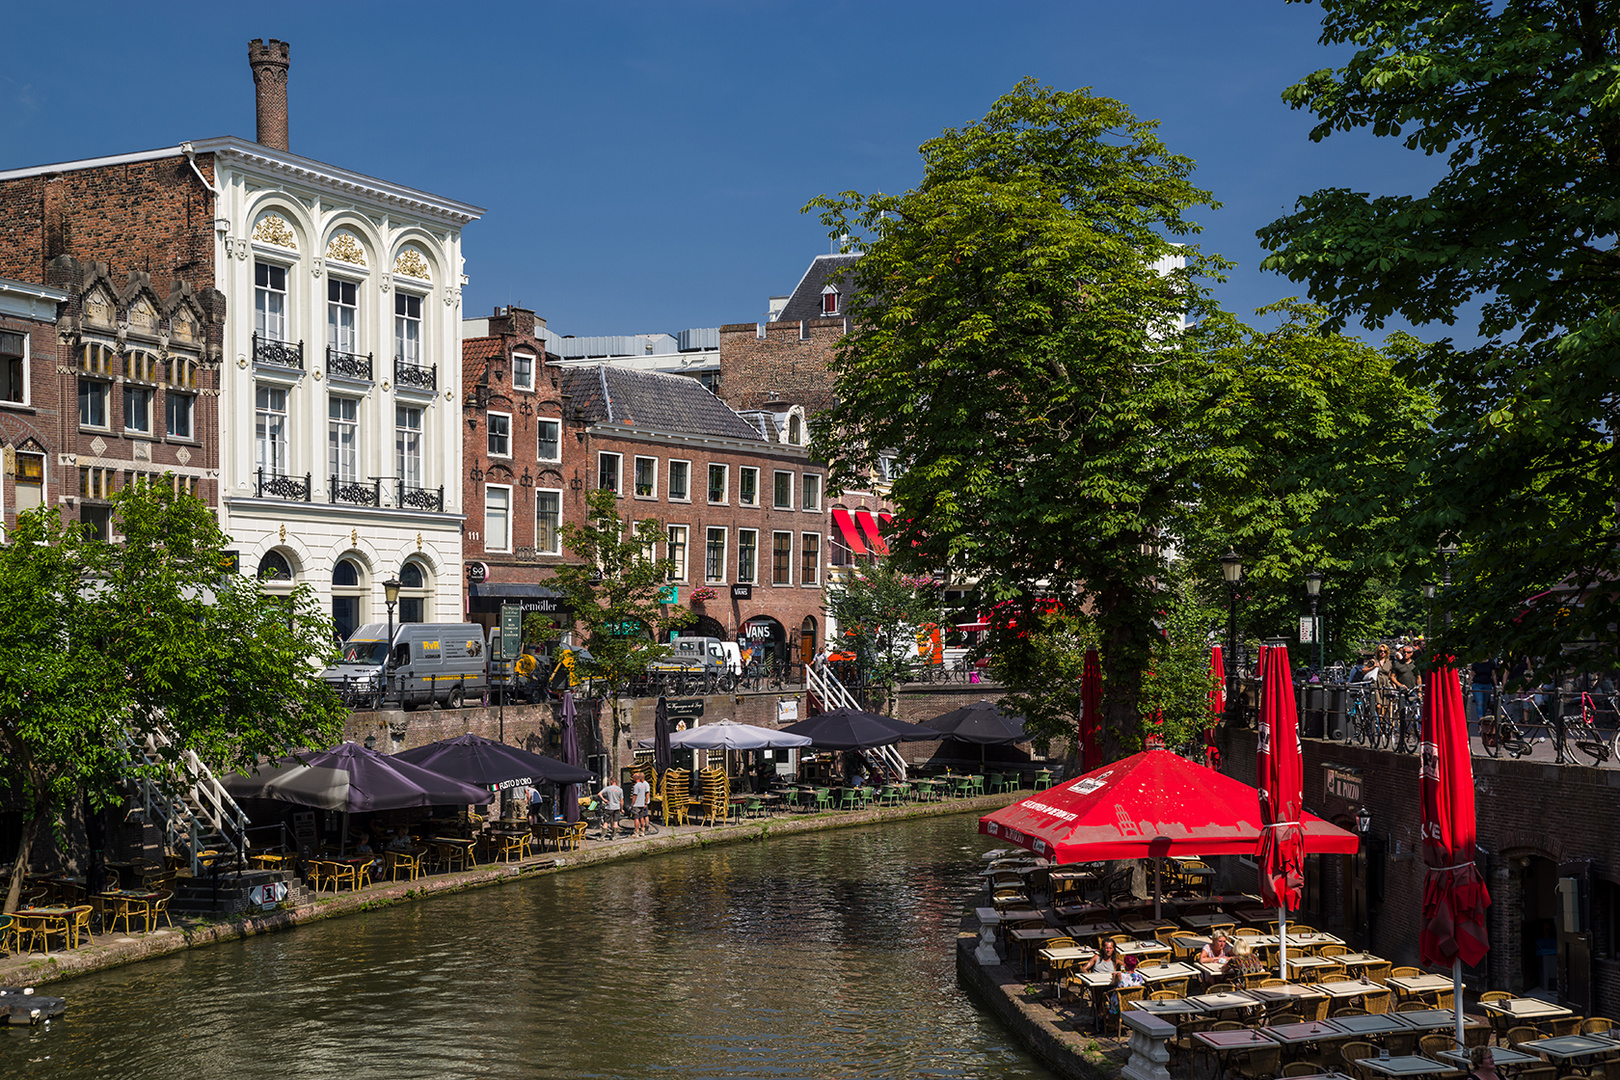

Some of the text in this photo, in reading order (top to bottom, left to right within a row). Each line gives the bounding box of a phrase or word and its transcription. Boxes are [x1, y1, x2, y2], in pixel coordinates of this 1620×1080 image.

[468, 531, 479, 541] 111
[733, 588, 748, 596] VANS
[503, 599, 558, 611] kemöller
[744, 622, 770, 638] VANS
[499, 779, 515, 790] RISTO
